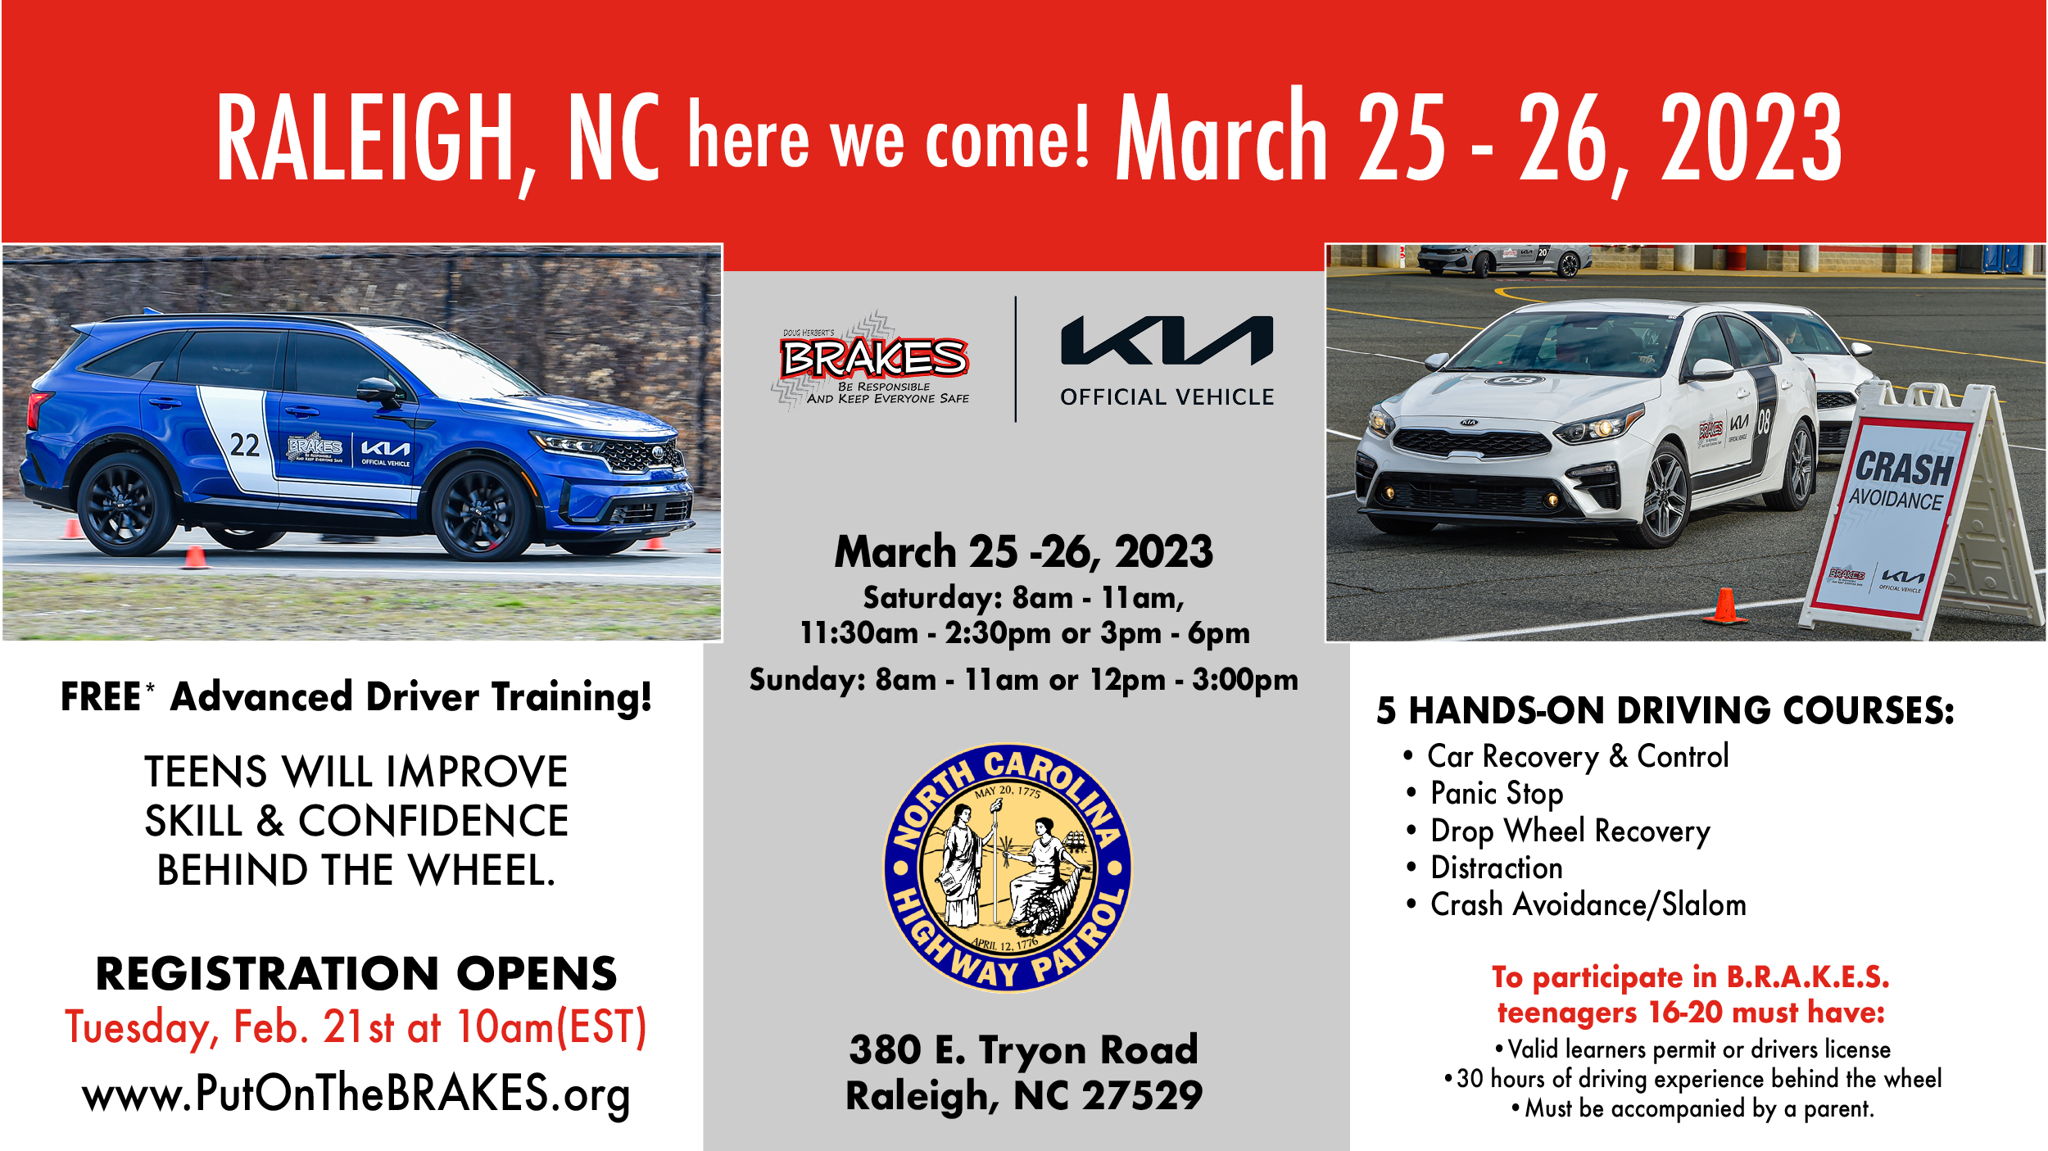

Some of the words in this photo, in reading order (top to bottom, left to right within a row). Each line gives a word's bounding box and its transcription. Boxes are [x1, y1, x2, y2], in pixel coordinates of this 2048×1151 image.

[218, 91, 537, 201] RALEIGH,
[570, 91, 659, 182] NC
[689, 96, 810, 168] here
[829, 123, 905, 168] we
[926, 103, 1089, 168] come!
[1116, 83, 1327, 182] March
[1358, 91, 1445, 182] 25
[1471, 144, 1494, 156] -
[1519, 91, 1629, 201] 26,
[1660, 91, 1842, 182] 2023
[1538, 248, 1547, 257] 20
[1060, 315, 1274, 366] KIA
[1060, 387, 1168, 406] OFFICIAL
[1175, 387, 1275, 406] VEHICLE
[1492, 376, 1537, 384] 08
[1730, 413, 1750, 431] KIA
[1758, 408, 1771, 435] 08
[230, 432, 260, 457] 22
[288, 439, 343, 455] BRAKES
[361, 440, 411, 457] KIA
[361, 458, 386, 466] OFFICIAL
[387, 460, 411, 468] VEHICLE
[1855, 450, 1955, 486] CRASH
[1849, 488, 1945, 511] AVOIDANCE
[834, 530, 957, 569] March
[969, 533, 1018, 569] 25
[1029, 533, 1101, 574] -26,
[1114, 533, 1214, 569] 2023
[1881, 569, 1926, 584] KIA
[863, 582, 1002, 617] Saturday:
[1012, 584, 1073, 610] 8am
[1102, 585, 1184, 613] 11am,
[801, 619, 919, 645] 11:30am
[945, 619, 1051, 652] 2:30pm
[1061, 626, 1092, 645] or
[1100, 619, 1162, 652] 3pm
[1187, 620, 1250, 652] 6pm
[749, 664, 866, 698] Sunday:
[875, 666, 936, 692] 8am
[965, 666, 1039, 691] 11am
[1048, 673, 1079, 692] or
[1091, 666, 1166, 698] 12pm
[1192, 666, 1299, 699] 3:00pm
[169, 677, 353, 712] Advanced
[367, 678, 480, 712] Driver
[490, 678, 652, 721] Training!
[1376, 695, 1397, 725] 5
[1409, 694, 1604, 725] HANDS-ON
[1617, 694, 1772, 725] DRIVING
[1783, 694, 1954, 725] COURSES:
[143, 753, 267, 789] TEENS
[280, 753, 373, 789] WILL
[387, 753, 568, 789] IMPROVE
[1427, 742, 1475, 769] Car
[1483, 742, 1600, 776] Recovery
[1609, 742, 1629, 768] &
[1637, 740, 1729, 769] Control
[893, 759, 976, 851] NORTH
[983, 751, 1122, 850] CAROLINA
[974, 786, 996, 799] MAY
[1018, 786, 1041, 799] 1775
[1432, 779, 1497, 805] Panic
[1506, 779, 1564, 813] Stop
[144, 803, 243, 838] SKILL
[256, 803, 285, 837] &
[298, 802, 568, 838] CONFIDENCE
[1432, 817, 1494, 851] Drop
[1502, 814, 1585, 843] Wheel
[1595, 817, 1712, 851] Recovery
[158, 851, 308, 887] BEHIND
[320, 852, 393, 886] THE
[406, 852, 555, 887] WHEEL.
[1432, 854, 1563, 880] Distraction
[1430, 888, 1503, 917] Crash
[1511, 888, 1747, 923] Avoidance/Slalom
[892, 887, 1019, 987] HIGHWAY
[1030, 887, 1125, 983] PATROL
[970, 937, 997, 951] APRIL
[1016, 936, 1039, 950] 1776
[96, 954, 438, 992] REGISTRATION
[456, 954, 617, 992] OPENS
[1491, 964, 1524, 989] To
[1533, 963, 1684, 996] participate
[1692, 963, 1717, 988] in
[1727, 964, 1890, 989] B.R.A.K.E.S.
[64, 1005, 219, 1055] Tuesday,
[235, 1005, 308, 1044] Feb.
[323, 1007, 395, 1044] 21st
[407, 1012, 442, 1044] at
[458, 1005, 646, 1052] 10am(EST)
[1497, 1002, 1638, 1031] teenagers
[1649, 999, 1724, 1024] 16-20
[1732, 1002, 1800, 1024] must
[1807, 997, 1885, 1024] have:
[849, 1033, 922, 1065] 380
[936, 1034, 966, 1065] E.
[978, 1034, 1086, 1071] Tryon
[1101, 1031, 1198, 1065] Road
[1507, 1036, 1558, 1059] Valid
[1566, 1036, 1647, 1059] learners
[1653, 1038, 1717, 1064] permit
[1722, 1044, 1745, 1059] or
[1750, 1036, 1819, 1059] drivers
[1825, 1036, 1892, 1059] license
[80, 1069, 630, 1124] www.PutOnTheBRAKES.org
[1456, 1067, 1484, 1089] 30
[1491, 1066, 1545, 1089] hours
[1552, 1065, 1573, 1089] of
[1578, 1066, 1647, 1095] driving
[1654, 1068, 1765, 1095] experience
[1771, 1066, 1839, 1089] behind
[1845, 1066, 1877, 1089] the
[1883, 1066, 1942, 1089] wheel
[846, 1077, 1000, 1120] Raleigh,
[1014, 1079, 1069, 1111] NC
[1082, 1079, 1204, 1111] 27529
[1524, 1096, 1573, 1118] Must
[1579, 1095, 1604, 1118] be
[1611, 1095, 1745, 1124] accompanied
[1752, 1095, 1778, 1124] by
[1784, 1103, 1797, 1118] a
[1804, 1100, 1875, 1124] parent.
